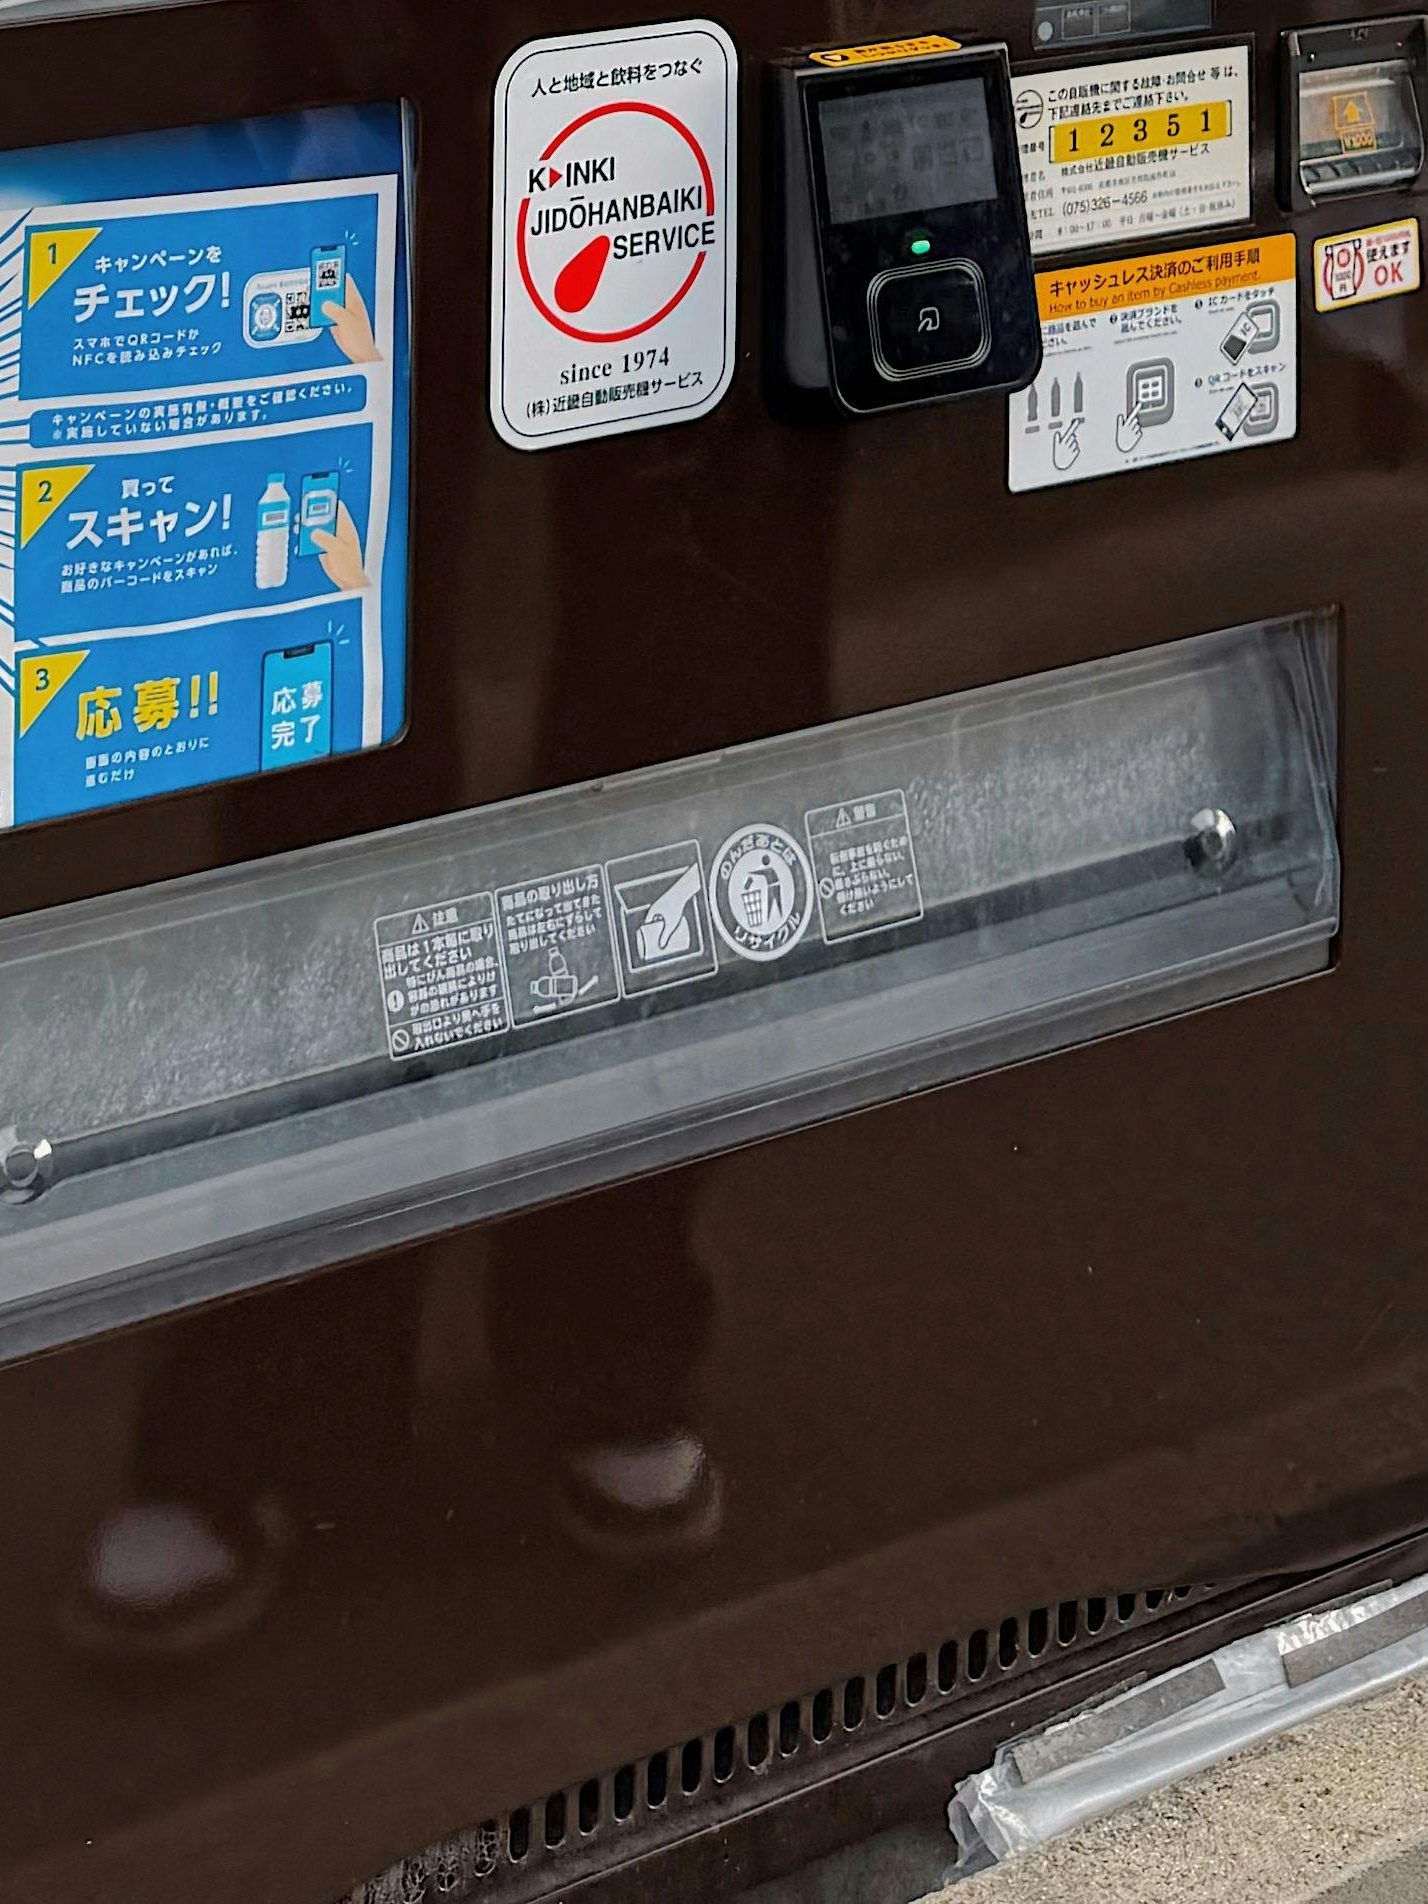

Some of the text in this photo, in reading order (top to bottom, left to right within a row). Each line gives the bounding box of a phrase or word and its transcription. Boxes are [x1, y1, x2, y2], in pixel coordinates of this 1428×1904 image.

[530, 57, 705, 98] 人と地域と飲料をつなぐ
[47, 243, 59, 266] 1
[613, 220, 716, 261] SERVICE
[94, 246, 222, 274] キャンペーンを
[1050, 247, 1260, 298] キャッシュレス決済のご利用手順
[1374, 261, 1403, 287] OK
[72, 271, 232, 325] チェック!
[1049, 303, 1072, 313] How
[1075, 301, 1086, 310] to
[1089, 296, 1109, 309] buy
[1112, 293, 1124, 304] an
[1127, 288, 1149, 302] item
[1153, 286, 1166, 300] by
[1169, 278, 1212, 295] Cashless
[71, 342, 222, 367] NFCを読み込みチェック
[72, 327, 200, 352] スマホでQRコードか
[560, 347, 671, 385] since 1974
[526, 370, 704, 419] (株)近畿自動販売機サービス
[38, 479, 53, 504] 2
[121, 475, 174, 499] 買って
[66, 494, 233, 553] スキャン!
[61, 565, 218, 594] 商品のバーコードをスキャン
[34, 668, 50, 692] 3
[270, 680, 324, 714] 応募
[75, 671, 220, 741] 応募!!
[270, 714, 321, 750] 完了
[721, 834, 797, 880] のんだあとは
[735, 912, 801, 949] リサイクル
